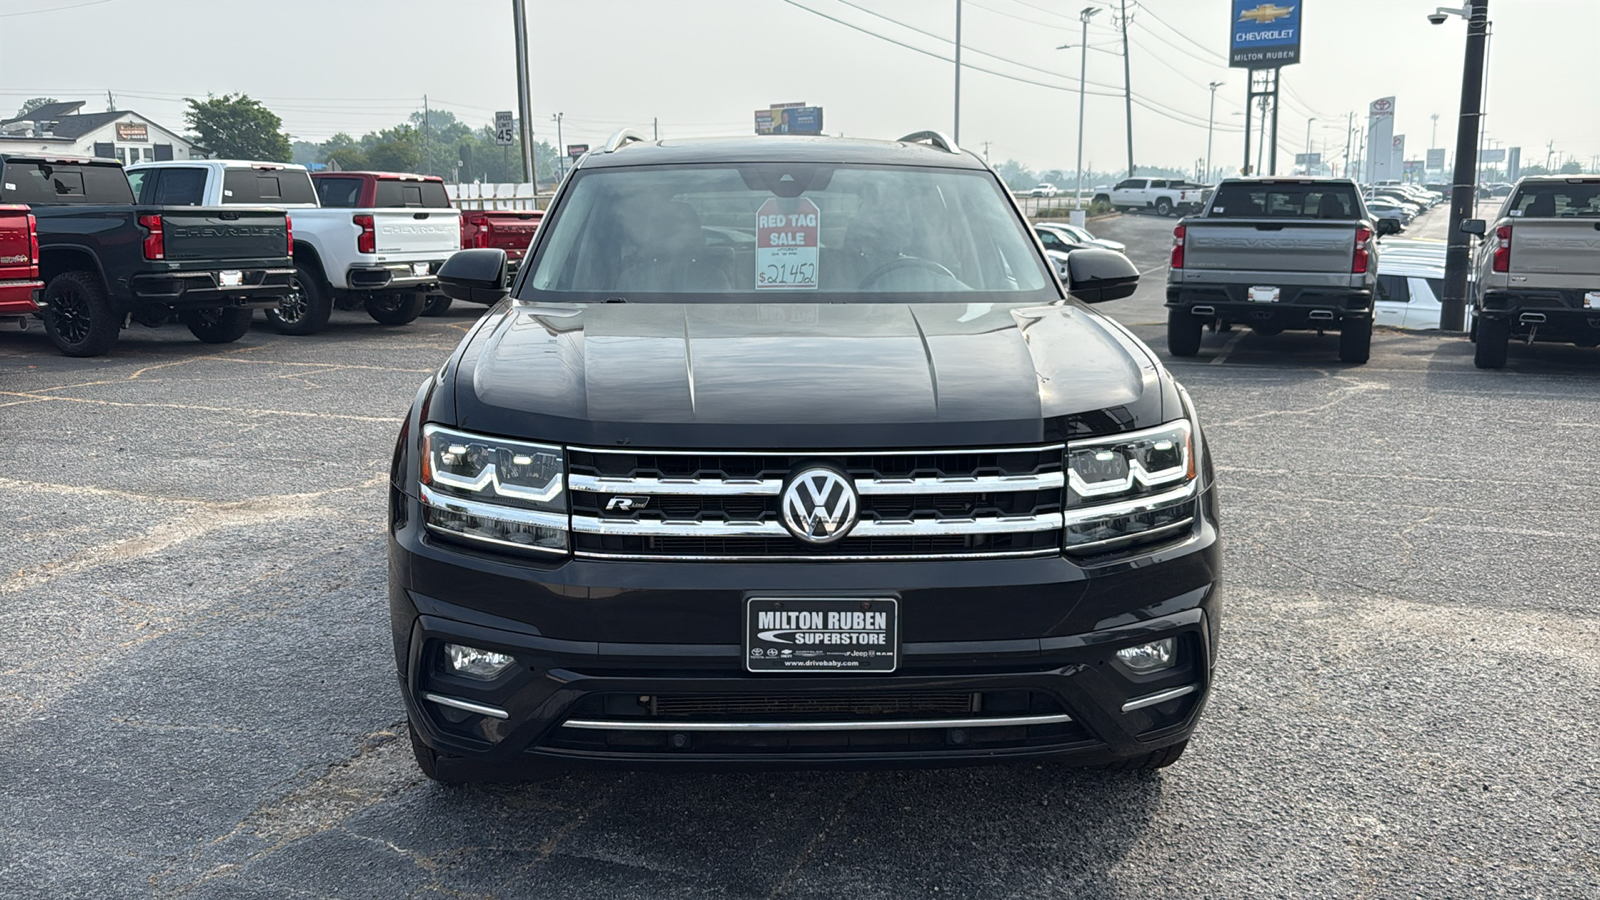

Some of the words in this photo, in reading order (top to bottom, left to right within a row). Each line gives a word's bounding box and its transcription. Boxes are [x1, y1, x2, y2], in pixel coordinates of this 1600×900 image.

[1236, 29, 1294, 42] CHEVROLET
[1234, 53, 1263, 61] MILTON
[1266, 51, 1294, 60] RUBEN
[497, 129, 512, 142] 45
[759, 215, 786, 229] RED
[788, 213, 816, 228] TAG
[174, 228, 286, 238] CHEVROLET
[382, 226, 455, 235] CHEVROLET
[769, 231, 805, 246] SALE
[758, 611, 823, 630] MILTON
[828, 611, 887, 630] RUBEN
[795, 633, 887, 645] SUPERSTORE
[851, 650, 868, 658] Jeep
[784, 660, 859, 668] www.drivebaby.com
